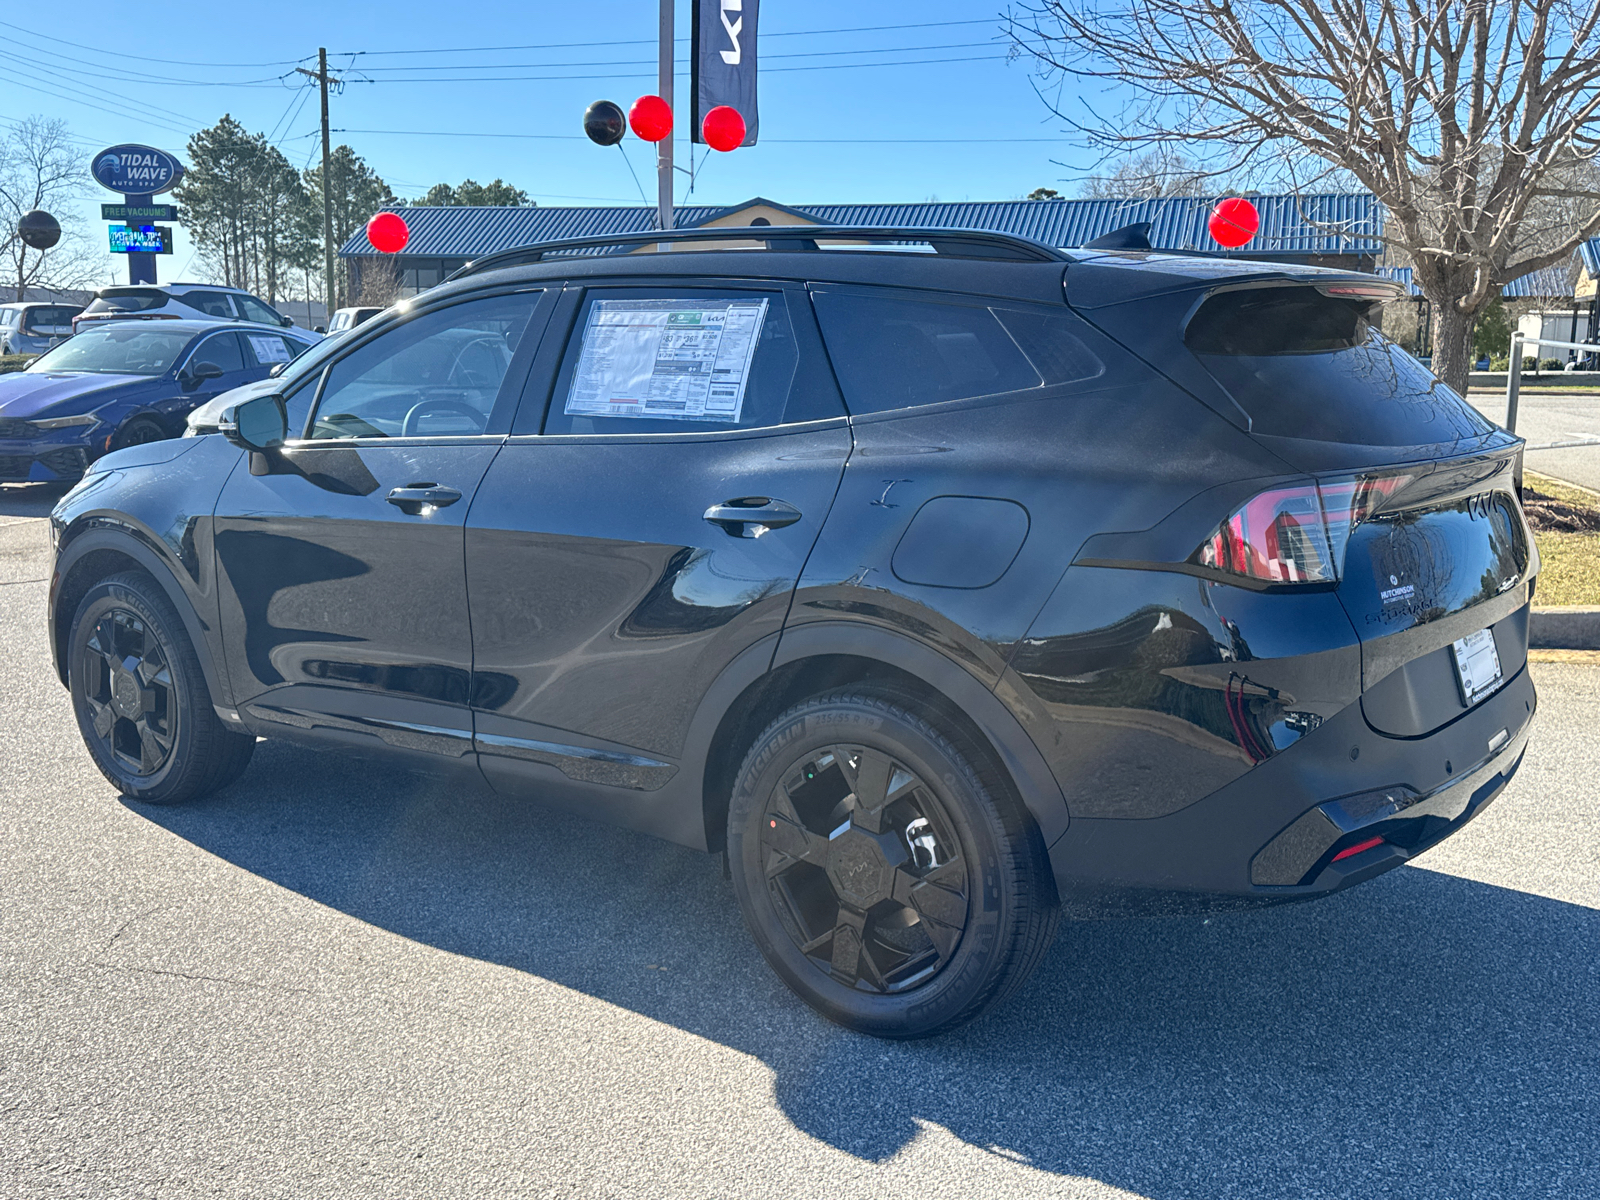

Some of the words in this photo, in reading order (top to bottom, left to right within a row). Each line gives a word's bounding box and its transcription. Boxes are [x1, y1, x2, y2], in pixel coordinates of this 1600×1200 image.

[719, 0, 742, 65] KI
[120, 154, 159, 166] TIDAL
[127, 168, 168, 180] WAVE
[105, 207, 126, 216] FREE
[127, 207, 167, 217] VACUUMS
[1380, 584, 1415, 600] HUTCHINSON
[126, 594, 168, 646] MICHELIN
[815, 714, 849, 725] 235/55
[865, 718, 875, 727] 19
[742, 722, 803, 796] MICHELIN
